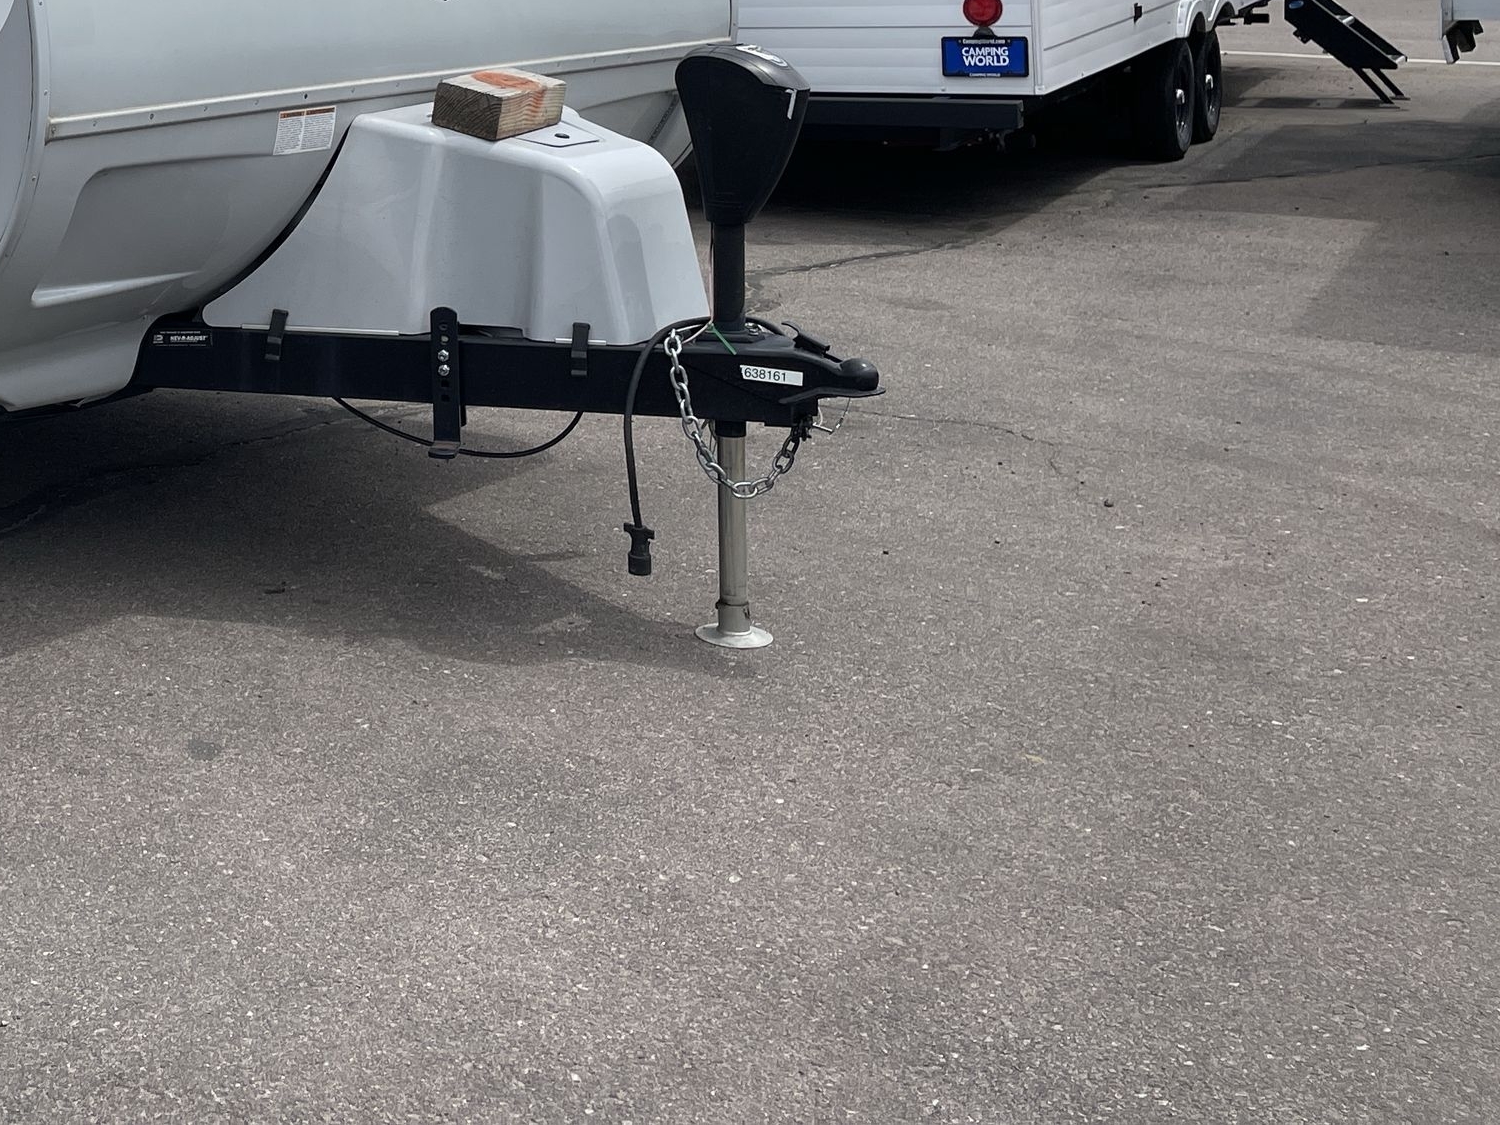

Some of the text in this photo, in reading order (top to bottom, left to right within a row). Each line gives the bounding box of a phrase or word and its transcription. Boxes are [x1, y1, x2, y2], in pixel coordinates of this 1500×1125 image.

[961, 47, 1009, 56] CAMPING
[963, 56, 1010, 66] WORLD
[744, 368, 786, 382] 638161
